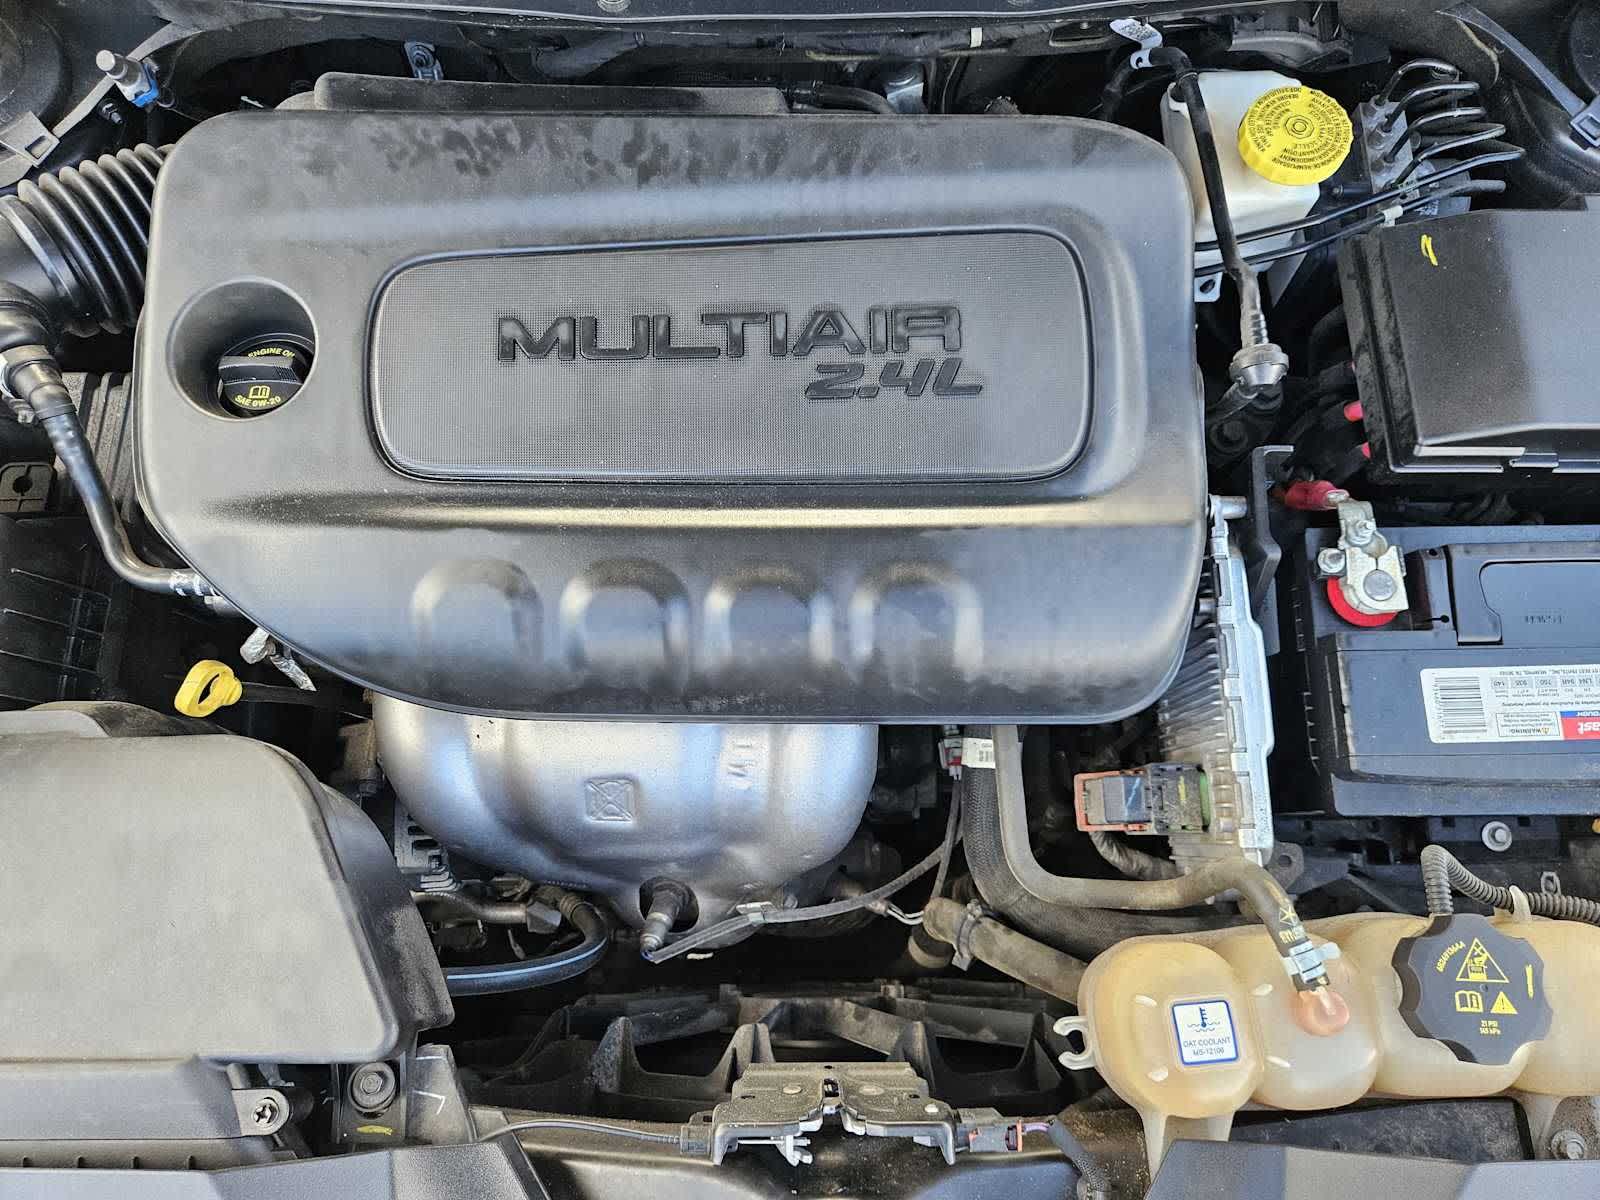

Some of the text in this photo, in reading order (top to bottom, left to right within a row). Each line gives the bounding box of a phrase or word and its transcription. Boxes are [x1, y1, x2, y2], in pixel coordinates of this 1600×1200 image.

[498, 304, 962, 361] MULTIAIR
[248, 347, 282, 358] ENGINE
[804, 356, 983, 399] 2.4L
[235, 395, 251, 407] SAE
[1197, 1036, 1231, 1046] COOLANT
